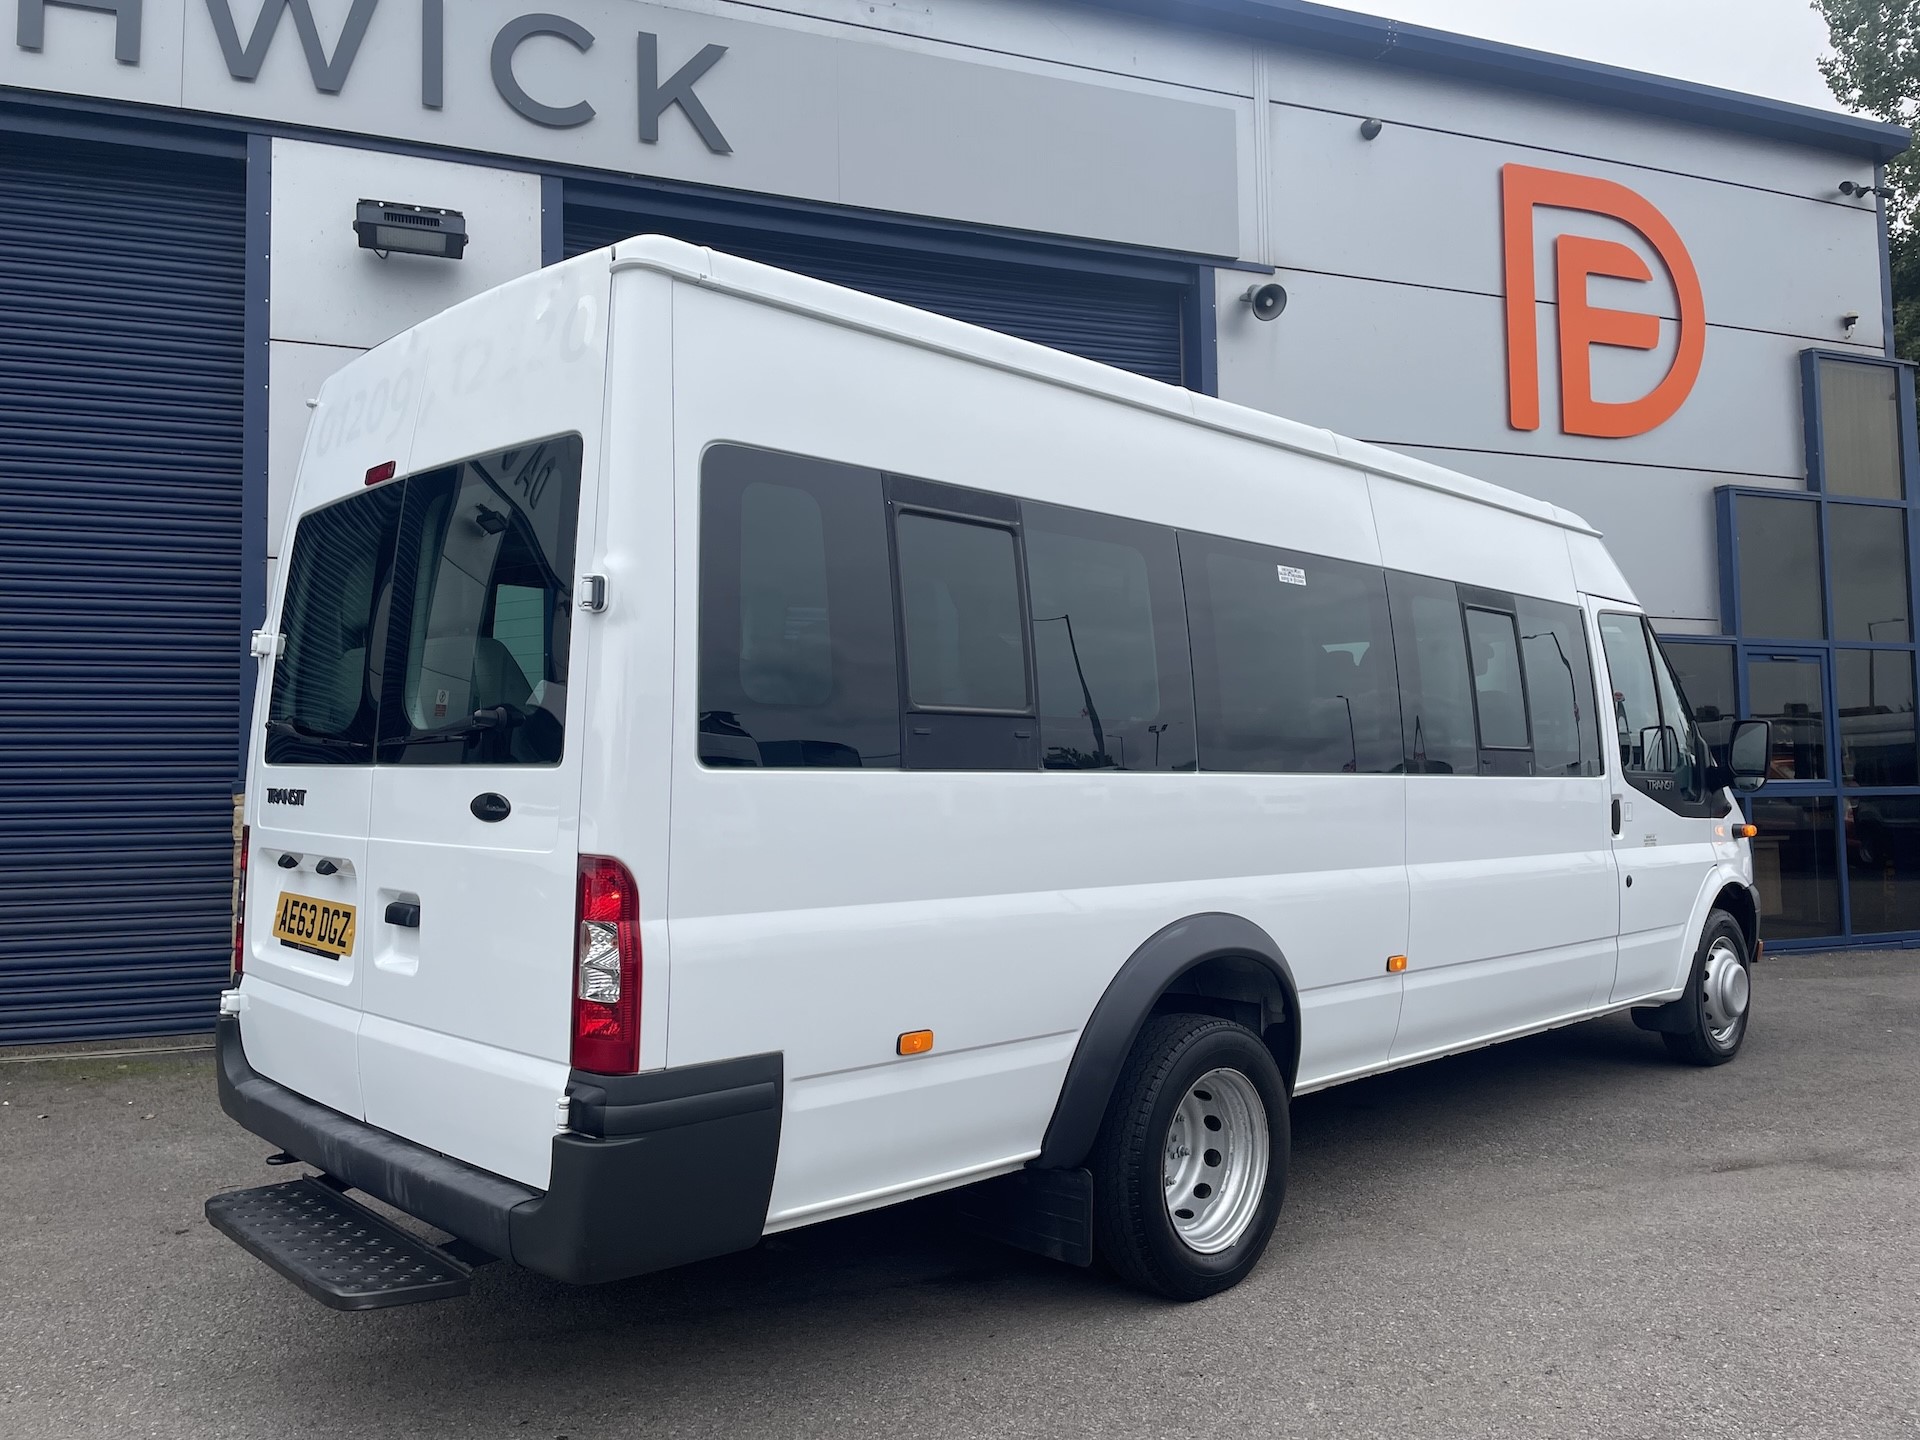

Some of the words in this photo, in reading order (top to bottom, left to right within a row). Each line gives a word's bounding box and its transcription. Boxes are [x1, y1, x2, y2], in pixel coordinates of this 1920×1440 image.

[1647, 780, 1675, 790] TRANSIT
[266, 788, 307, 806] TRANSIT
[279, 898, 317, 939] AE63
[317, 906, 352, 948] DGZ
